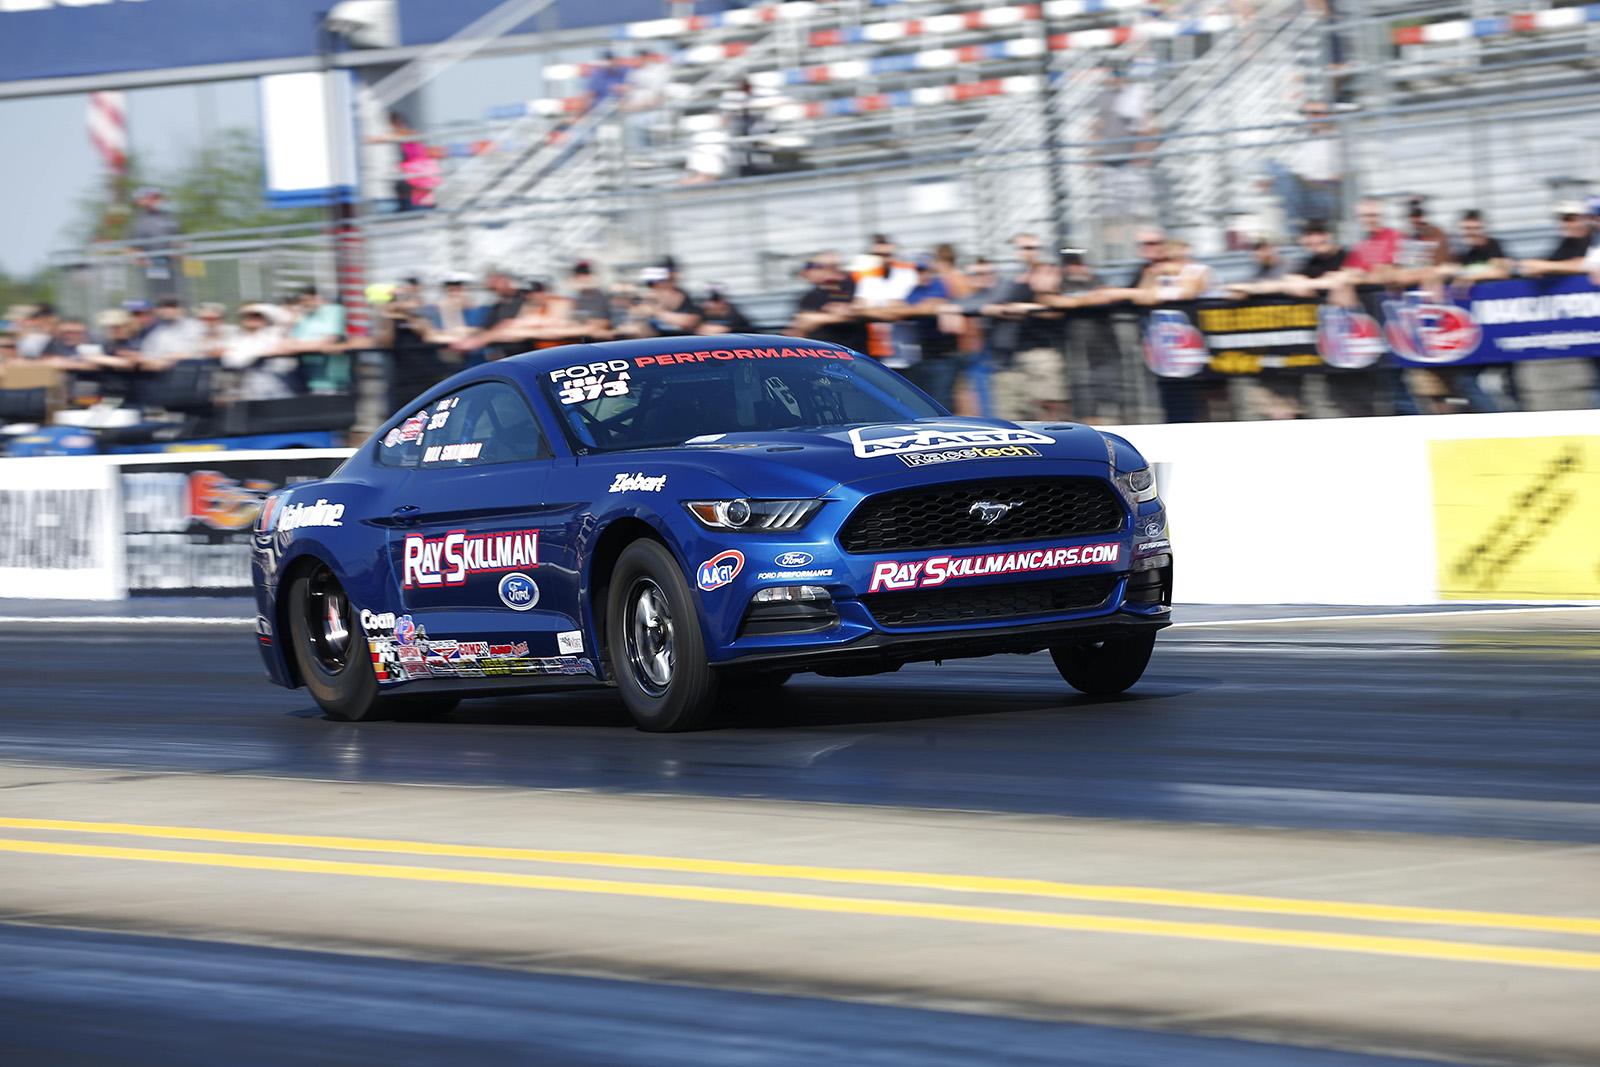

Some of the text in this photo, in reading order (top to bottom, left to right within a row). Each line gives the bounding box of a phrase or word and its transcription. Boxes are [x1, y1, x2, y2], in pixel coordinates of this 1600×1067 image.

[549, 347, 854, 383] FORD PERFORMANCE
[559, 380, 630, 404] 373
[858, 430, 1043, 455] AXALTA
[404, 530, 539, 586] RAY SKILLMAN
[781, 551, 807, 565] Ford
[757, 568, 833, 580] FORD PERFORMANCE
[508, 581, 531, 602] Ford
[360, 608, 396, 630] Coan
[459, 643, 481, 656] COMP
